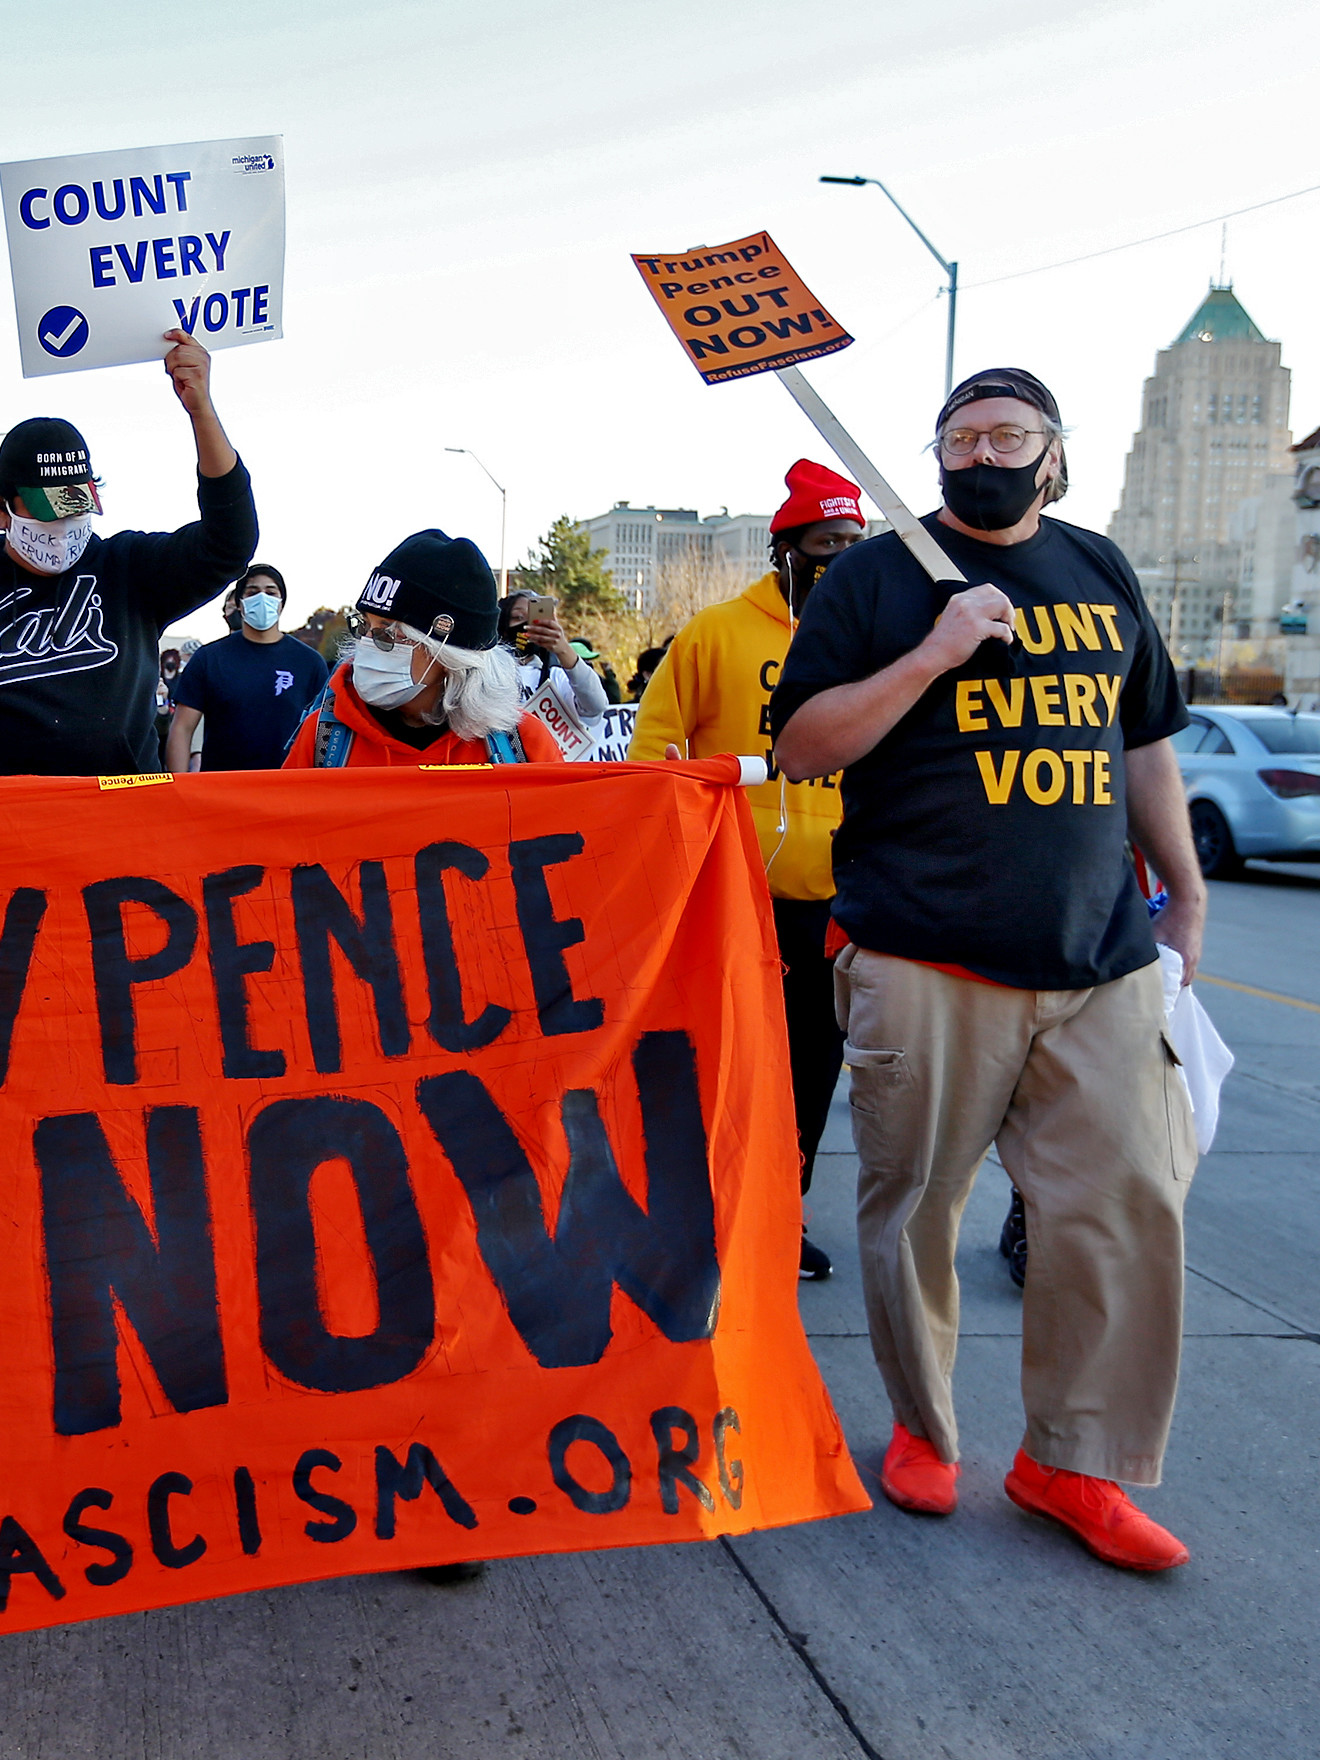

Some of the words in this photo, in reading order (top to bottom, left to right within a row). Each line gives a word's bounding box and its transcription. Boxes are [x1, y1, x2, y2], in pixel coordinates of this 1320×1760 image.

[232, 154, 264, 165] michigan
[244, 162, 266, 171] united
[19, 171, 192, 230] COUNT
[89, 230, 232, 288] EVERY
[639, 235, 770, 275] Trump/
[659, 266, 781, 299] Pence
[173, 285, 269, 336] VOTE
[684, 286, 790, 326] OUT
[685, 309, 834, 359] NOW!
[706, 337, 852, 382] RefuseFascism.org
[37, 453, 63, 463] BORN
[65, 451, 76, 463] OF
[20, 540, 61, 566] TRUMP
[22, 526, 56, 546] FUCK
[361, 573, 401, 606] NO!
[935, 603, 1124, 655] UNT
[956, 673, 1121, 732] EVERY
[539, 697, 582, 749] COUNT
[602, 708, 639, 739] TR
[100, 774, 172, 786] Trump/Pence
[975, 748, 1112, 806] VOTE
[32, 1030, 721, 1437] NOW
